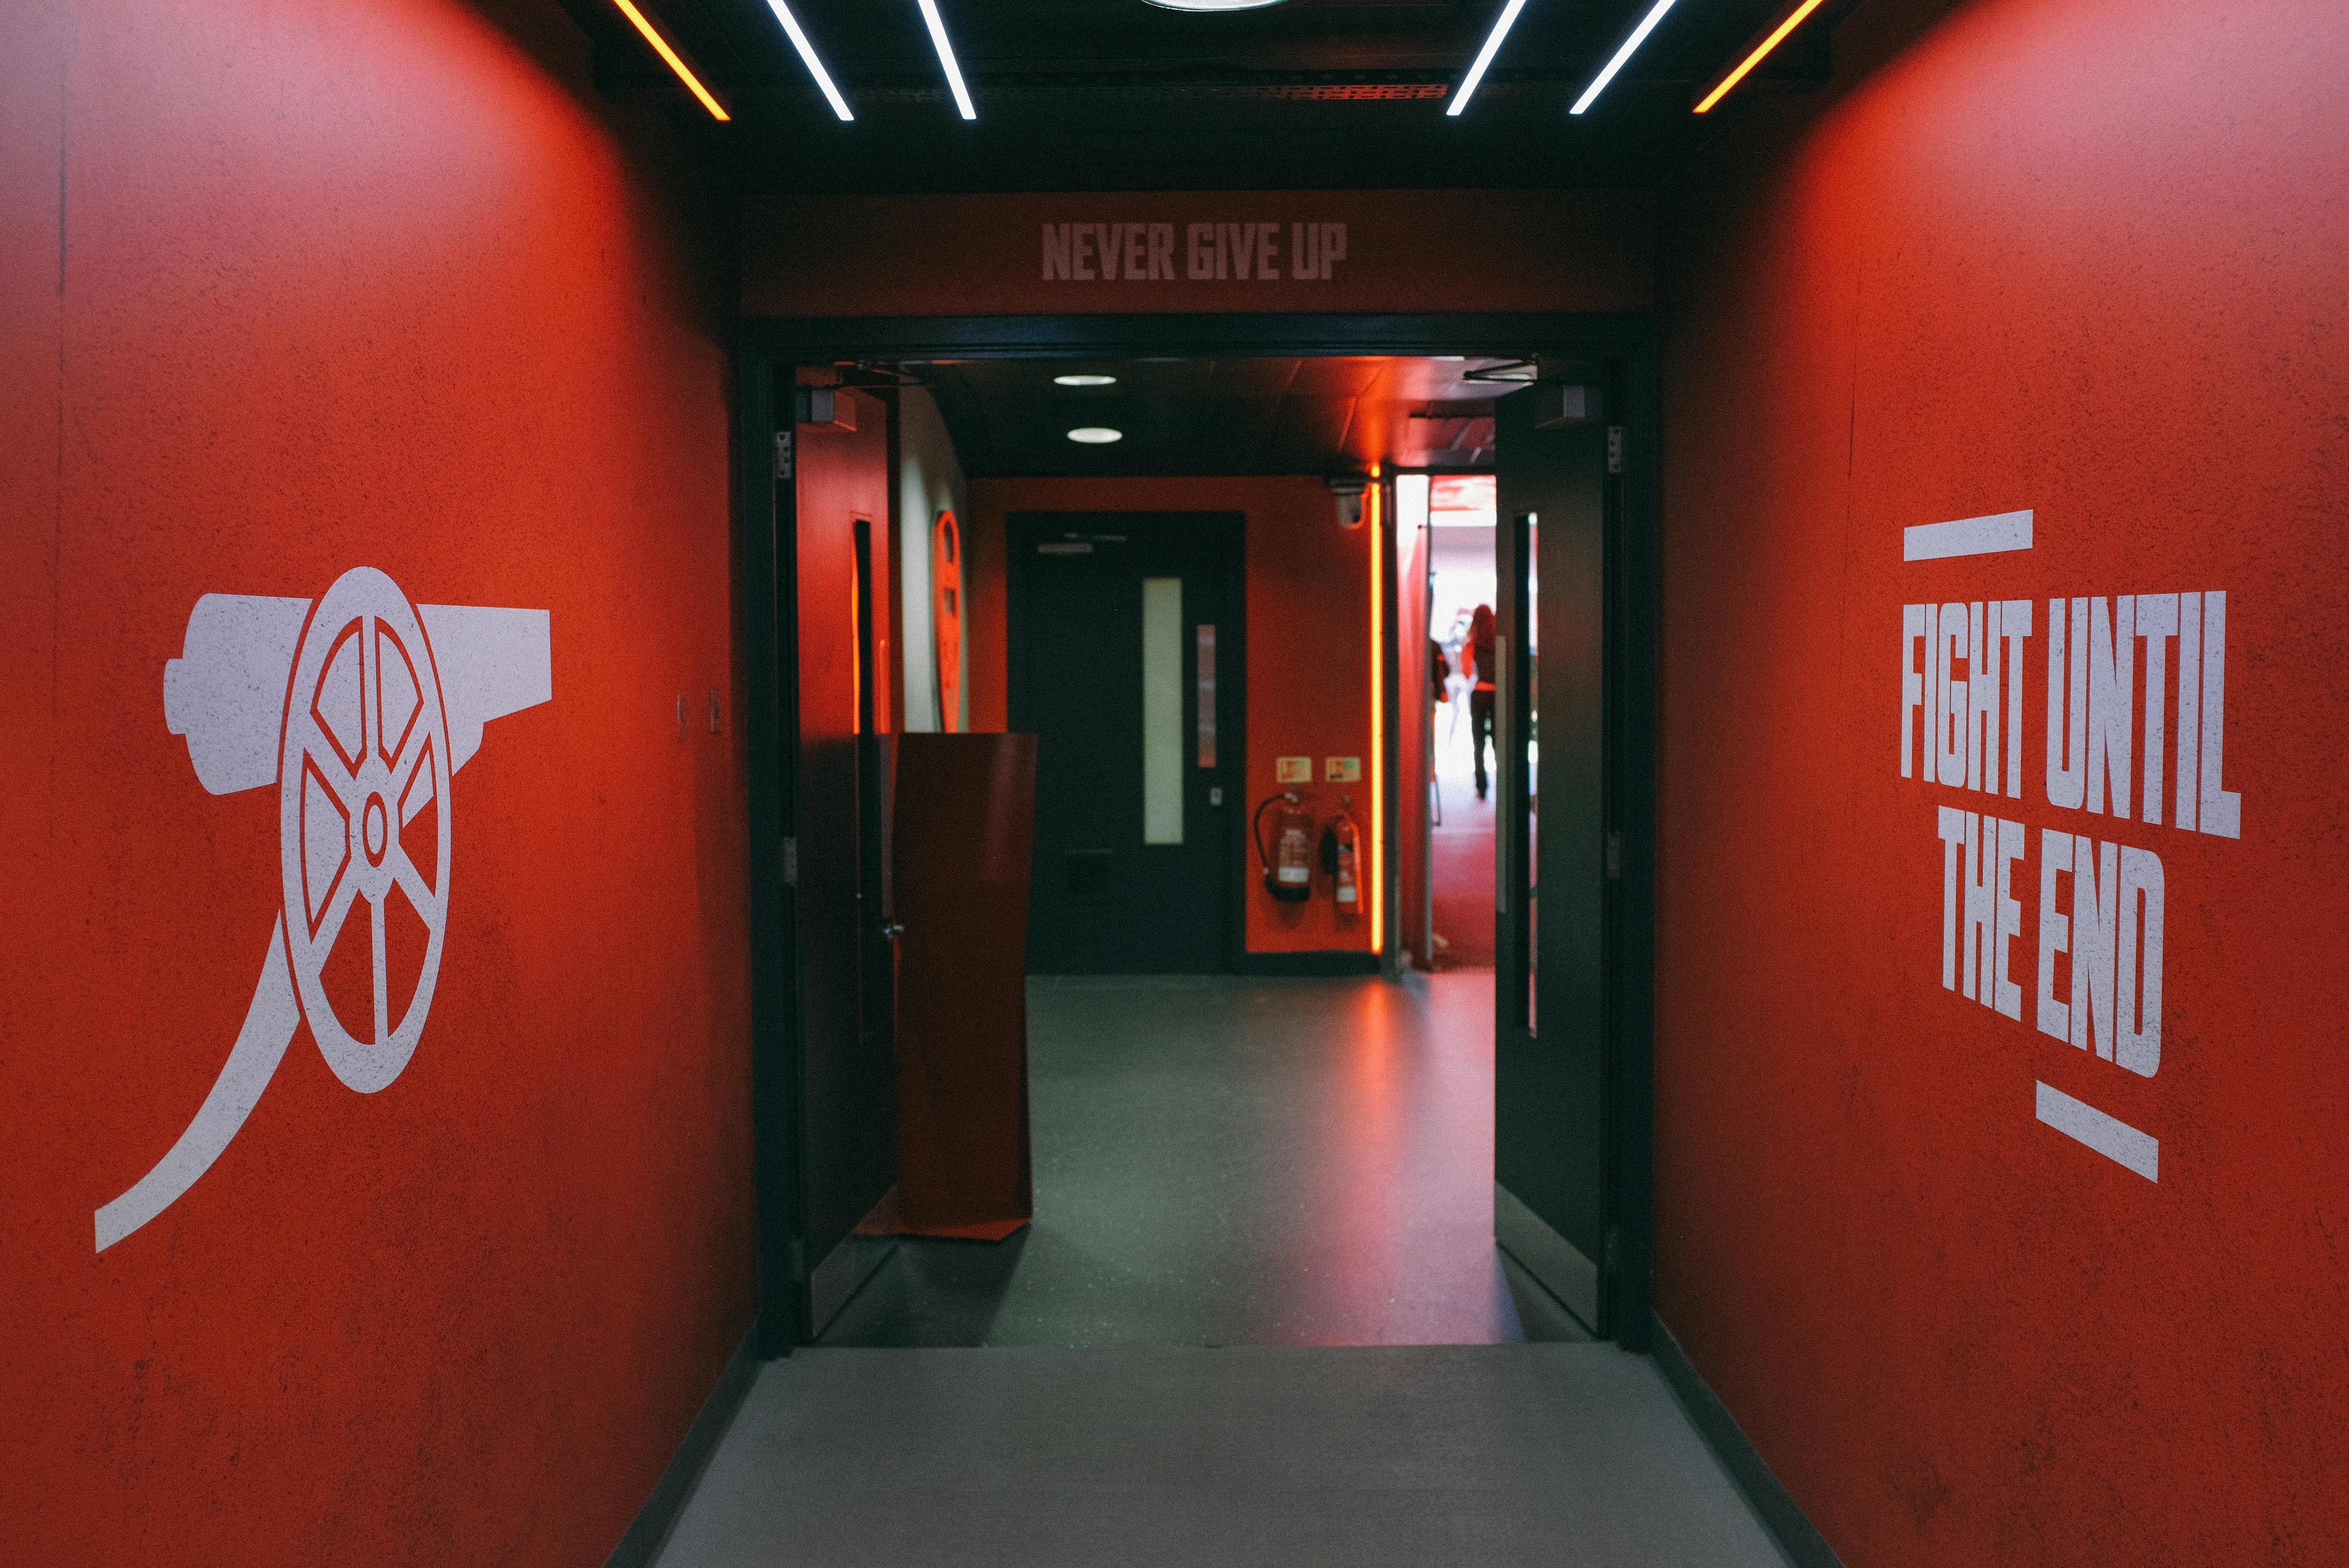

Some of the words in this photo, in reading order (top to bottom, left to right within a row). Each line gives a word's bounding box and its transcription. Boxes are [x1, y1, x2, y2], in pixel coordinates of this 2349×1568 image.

[1042, 223, 1176, 280] NEVER
[1187, 223, 1280, 280] GIVE
[1292, 223, 1347, 280] UP
[1901, 600, 2032, 799] FIGHT
[2046, 591, 2241, 839] UNTIL
[1938, 806, 2025, 1022] THE
[2036, 828, 2165, 1079] END
